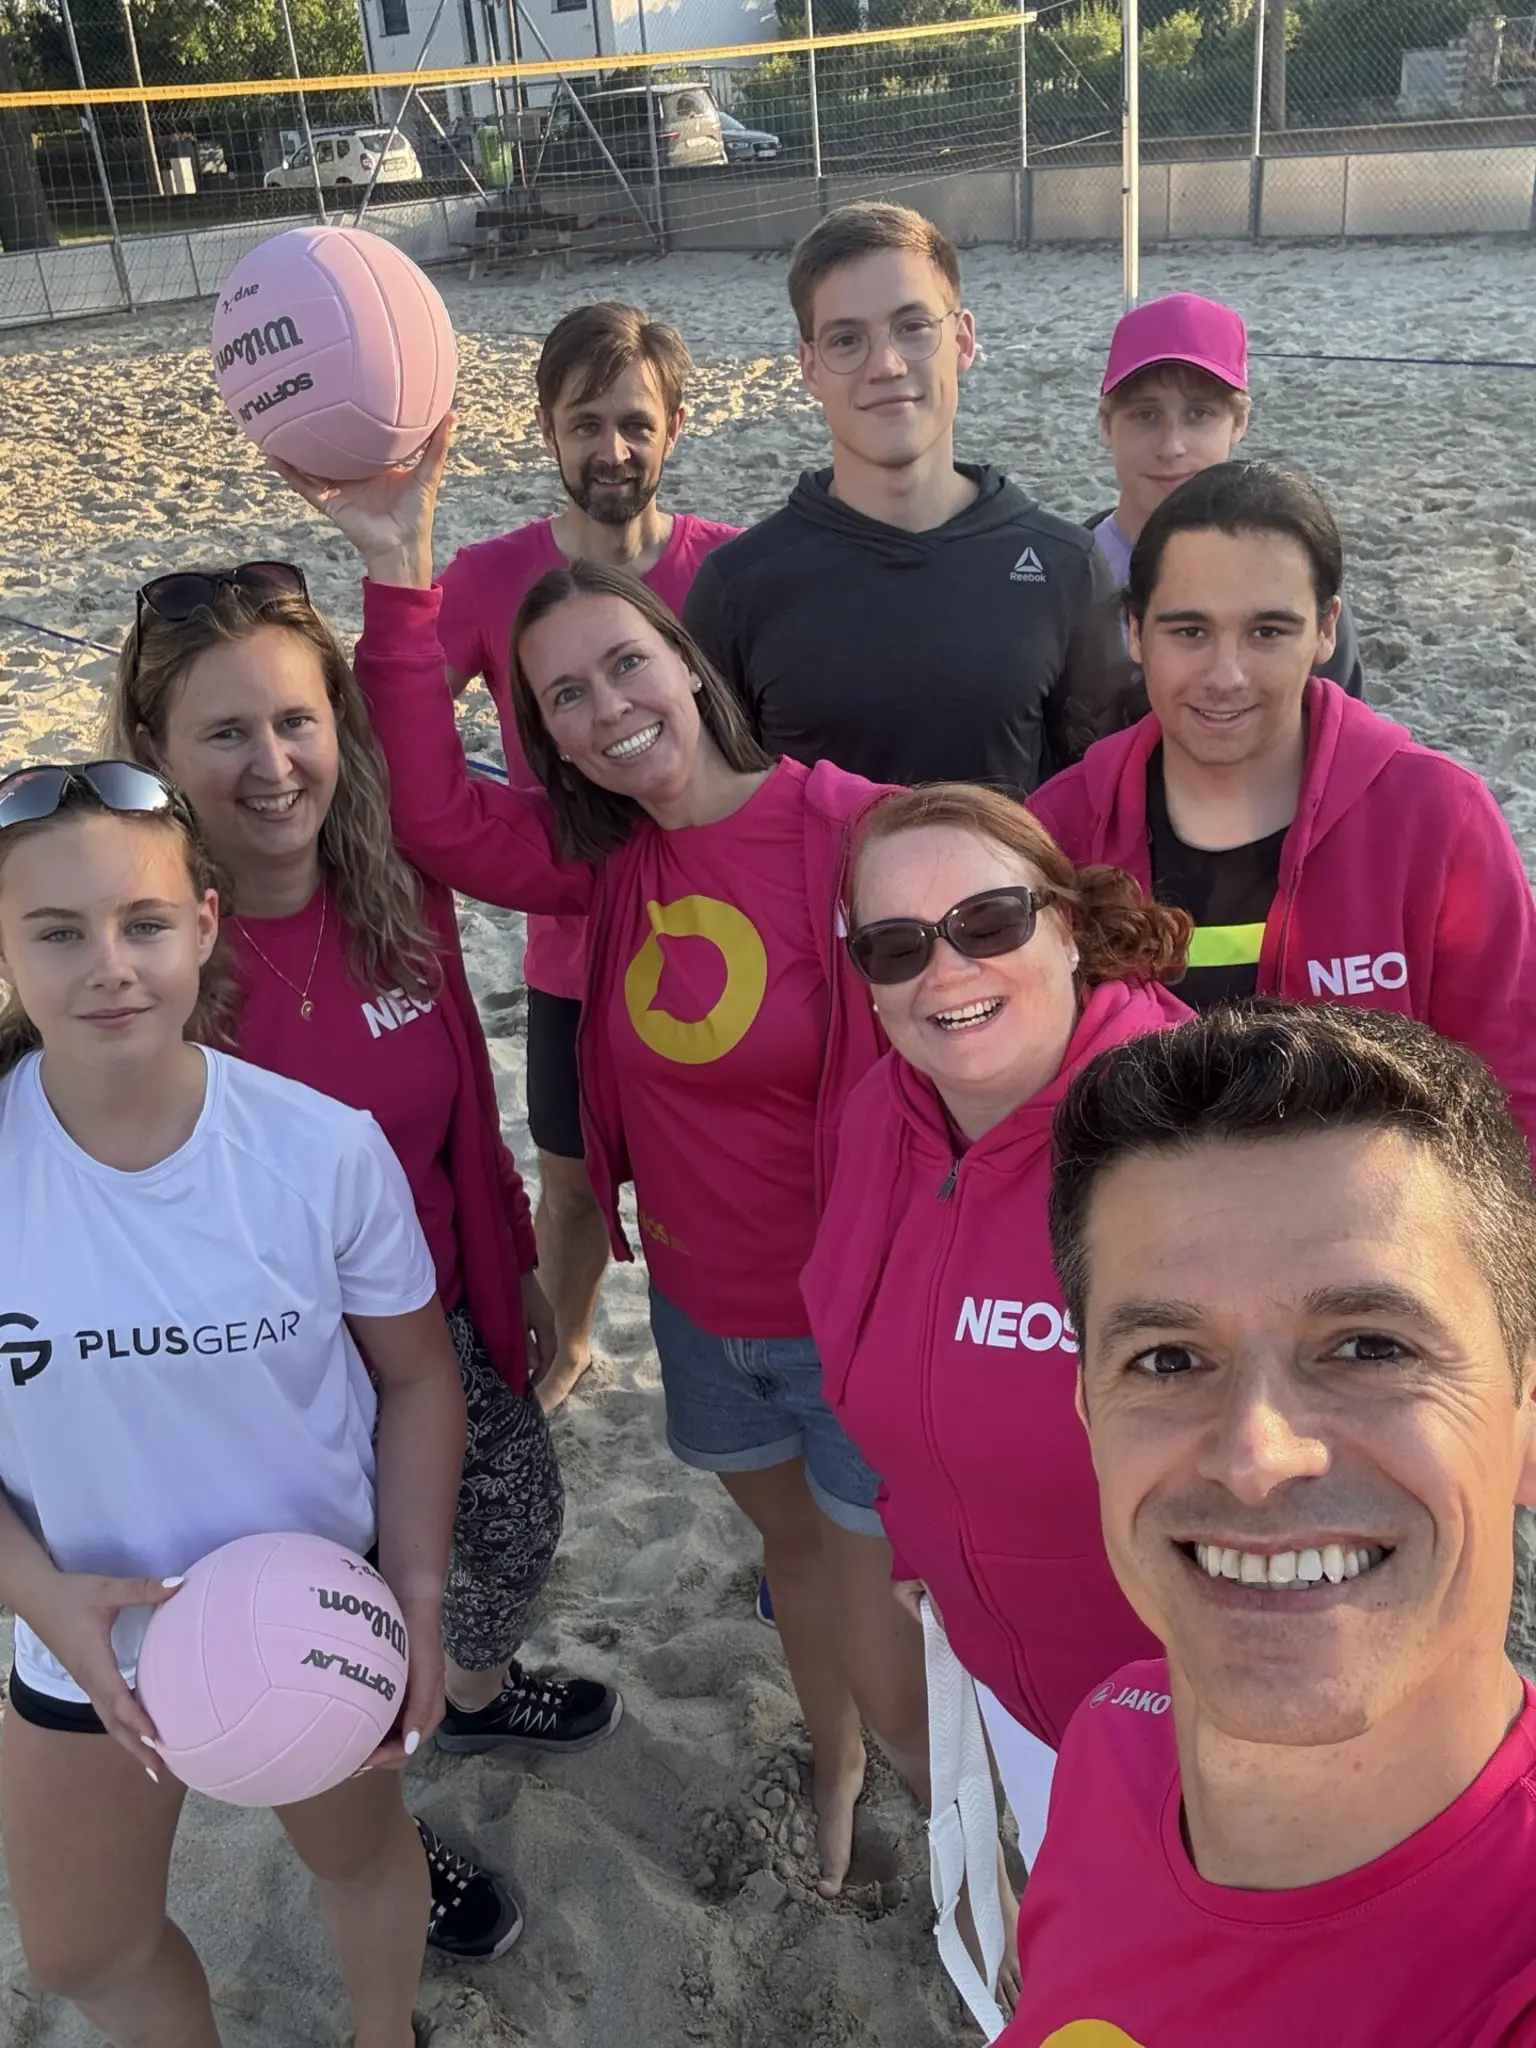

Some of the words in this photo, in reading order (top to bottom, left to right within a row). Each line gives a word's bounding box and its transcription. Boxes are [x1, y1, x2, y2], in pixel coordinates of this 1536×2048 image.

[216, 316, 304, 375] Wilson
[238, 372, 314, 425] SOFTPLA
[1009, 571, 1048, 583] Reebok
[74, 1311, 300, 1359] PLUSGEAR
[317, 1588, 406, 1661] Wilson
[300, 1649, 396, 1701] SOFTPLAY
[1111, 1687, 1172, 1714] JAKO
